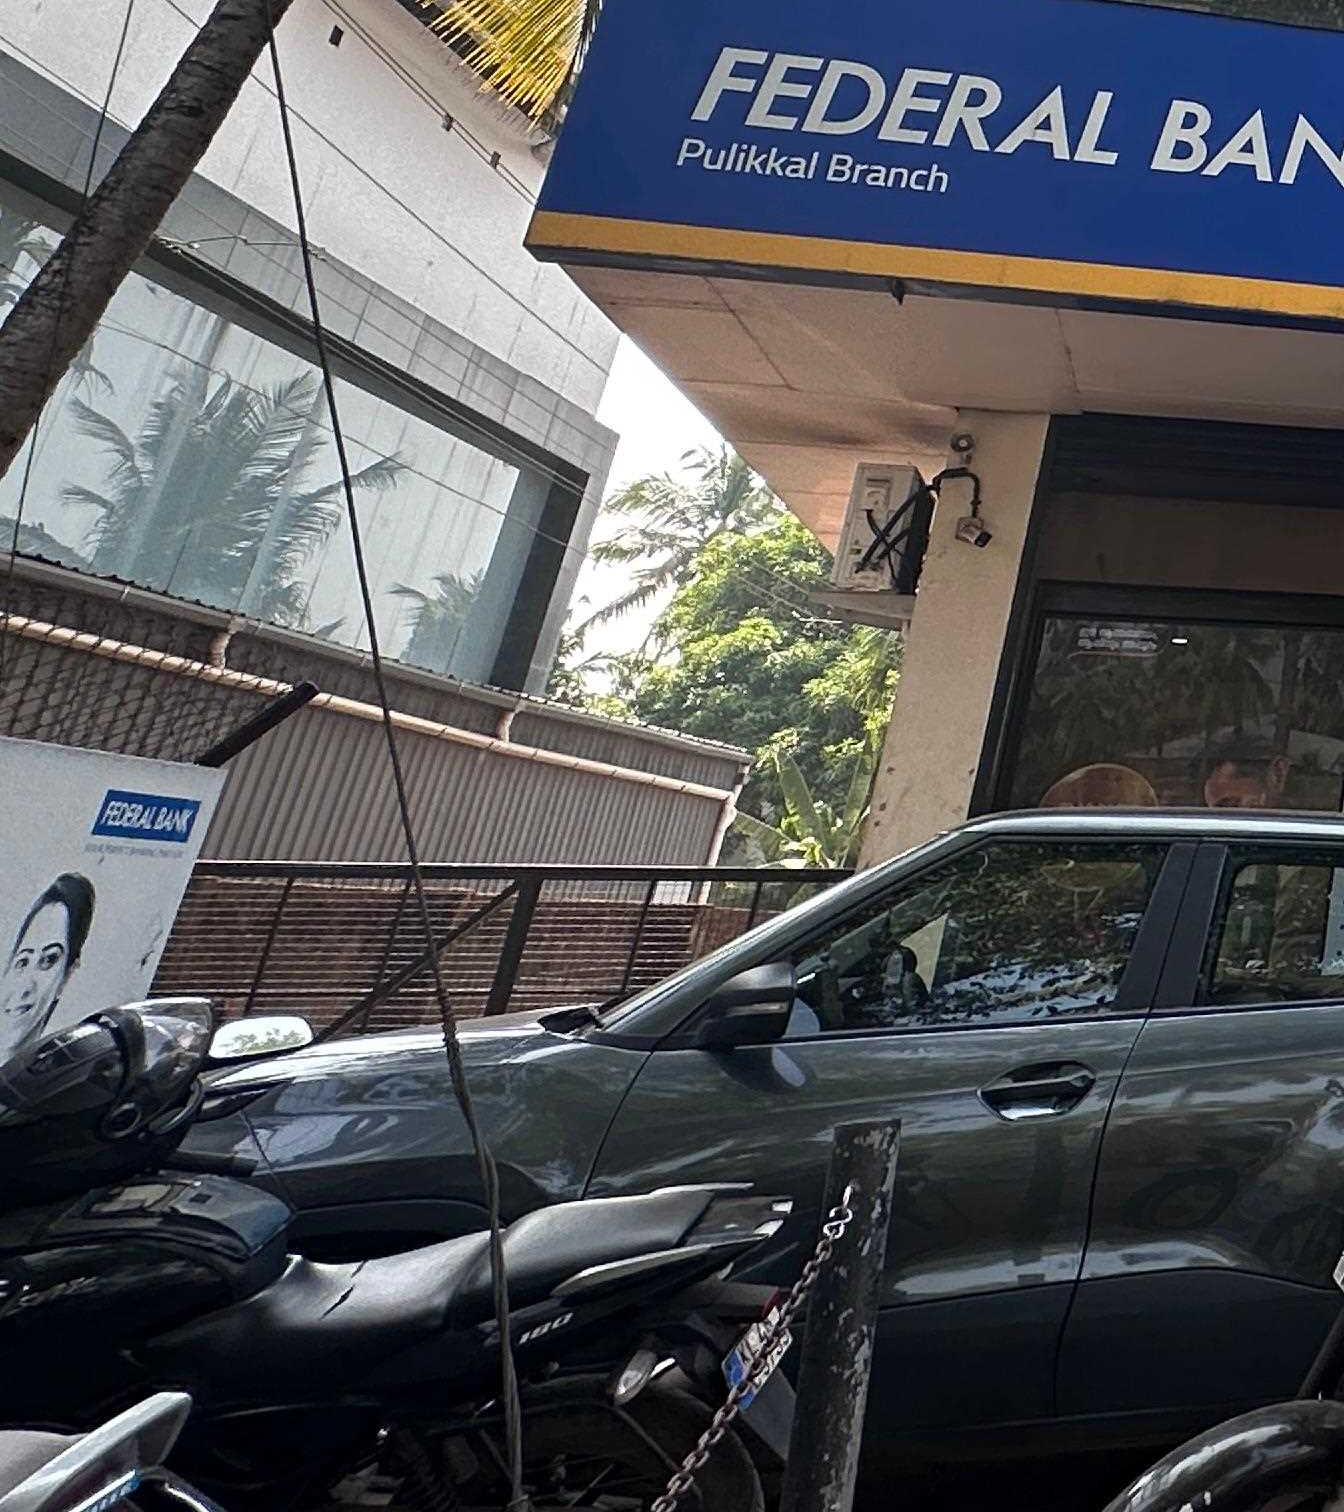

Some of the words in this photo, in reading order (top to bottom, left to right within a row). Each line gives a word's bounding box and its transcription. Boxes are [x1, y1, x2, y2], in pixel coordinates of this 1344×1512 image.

[691, 47, 1120, 166] FEDERAL
[676, 138, 819, 182] Pulikkal
[826, 152, 949, 194] Branch
